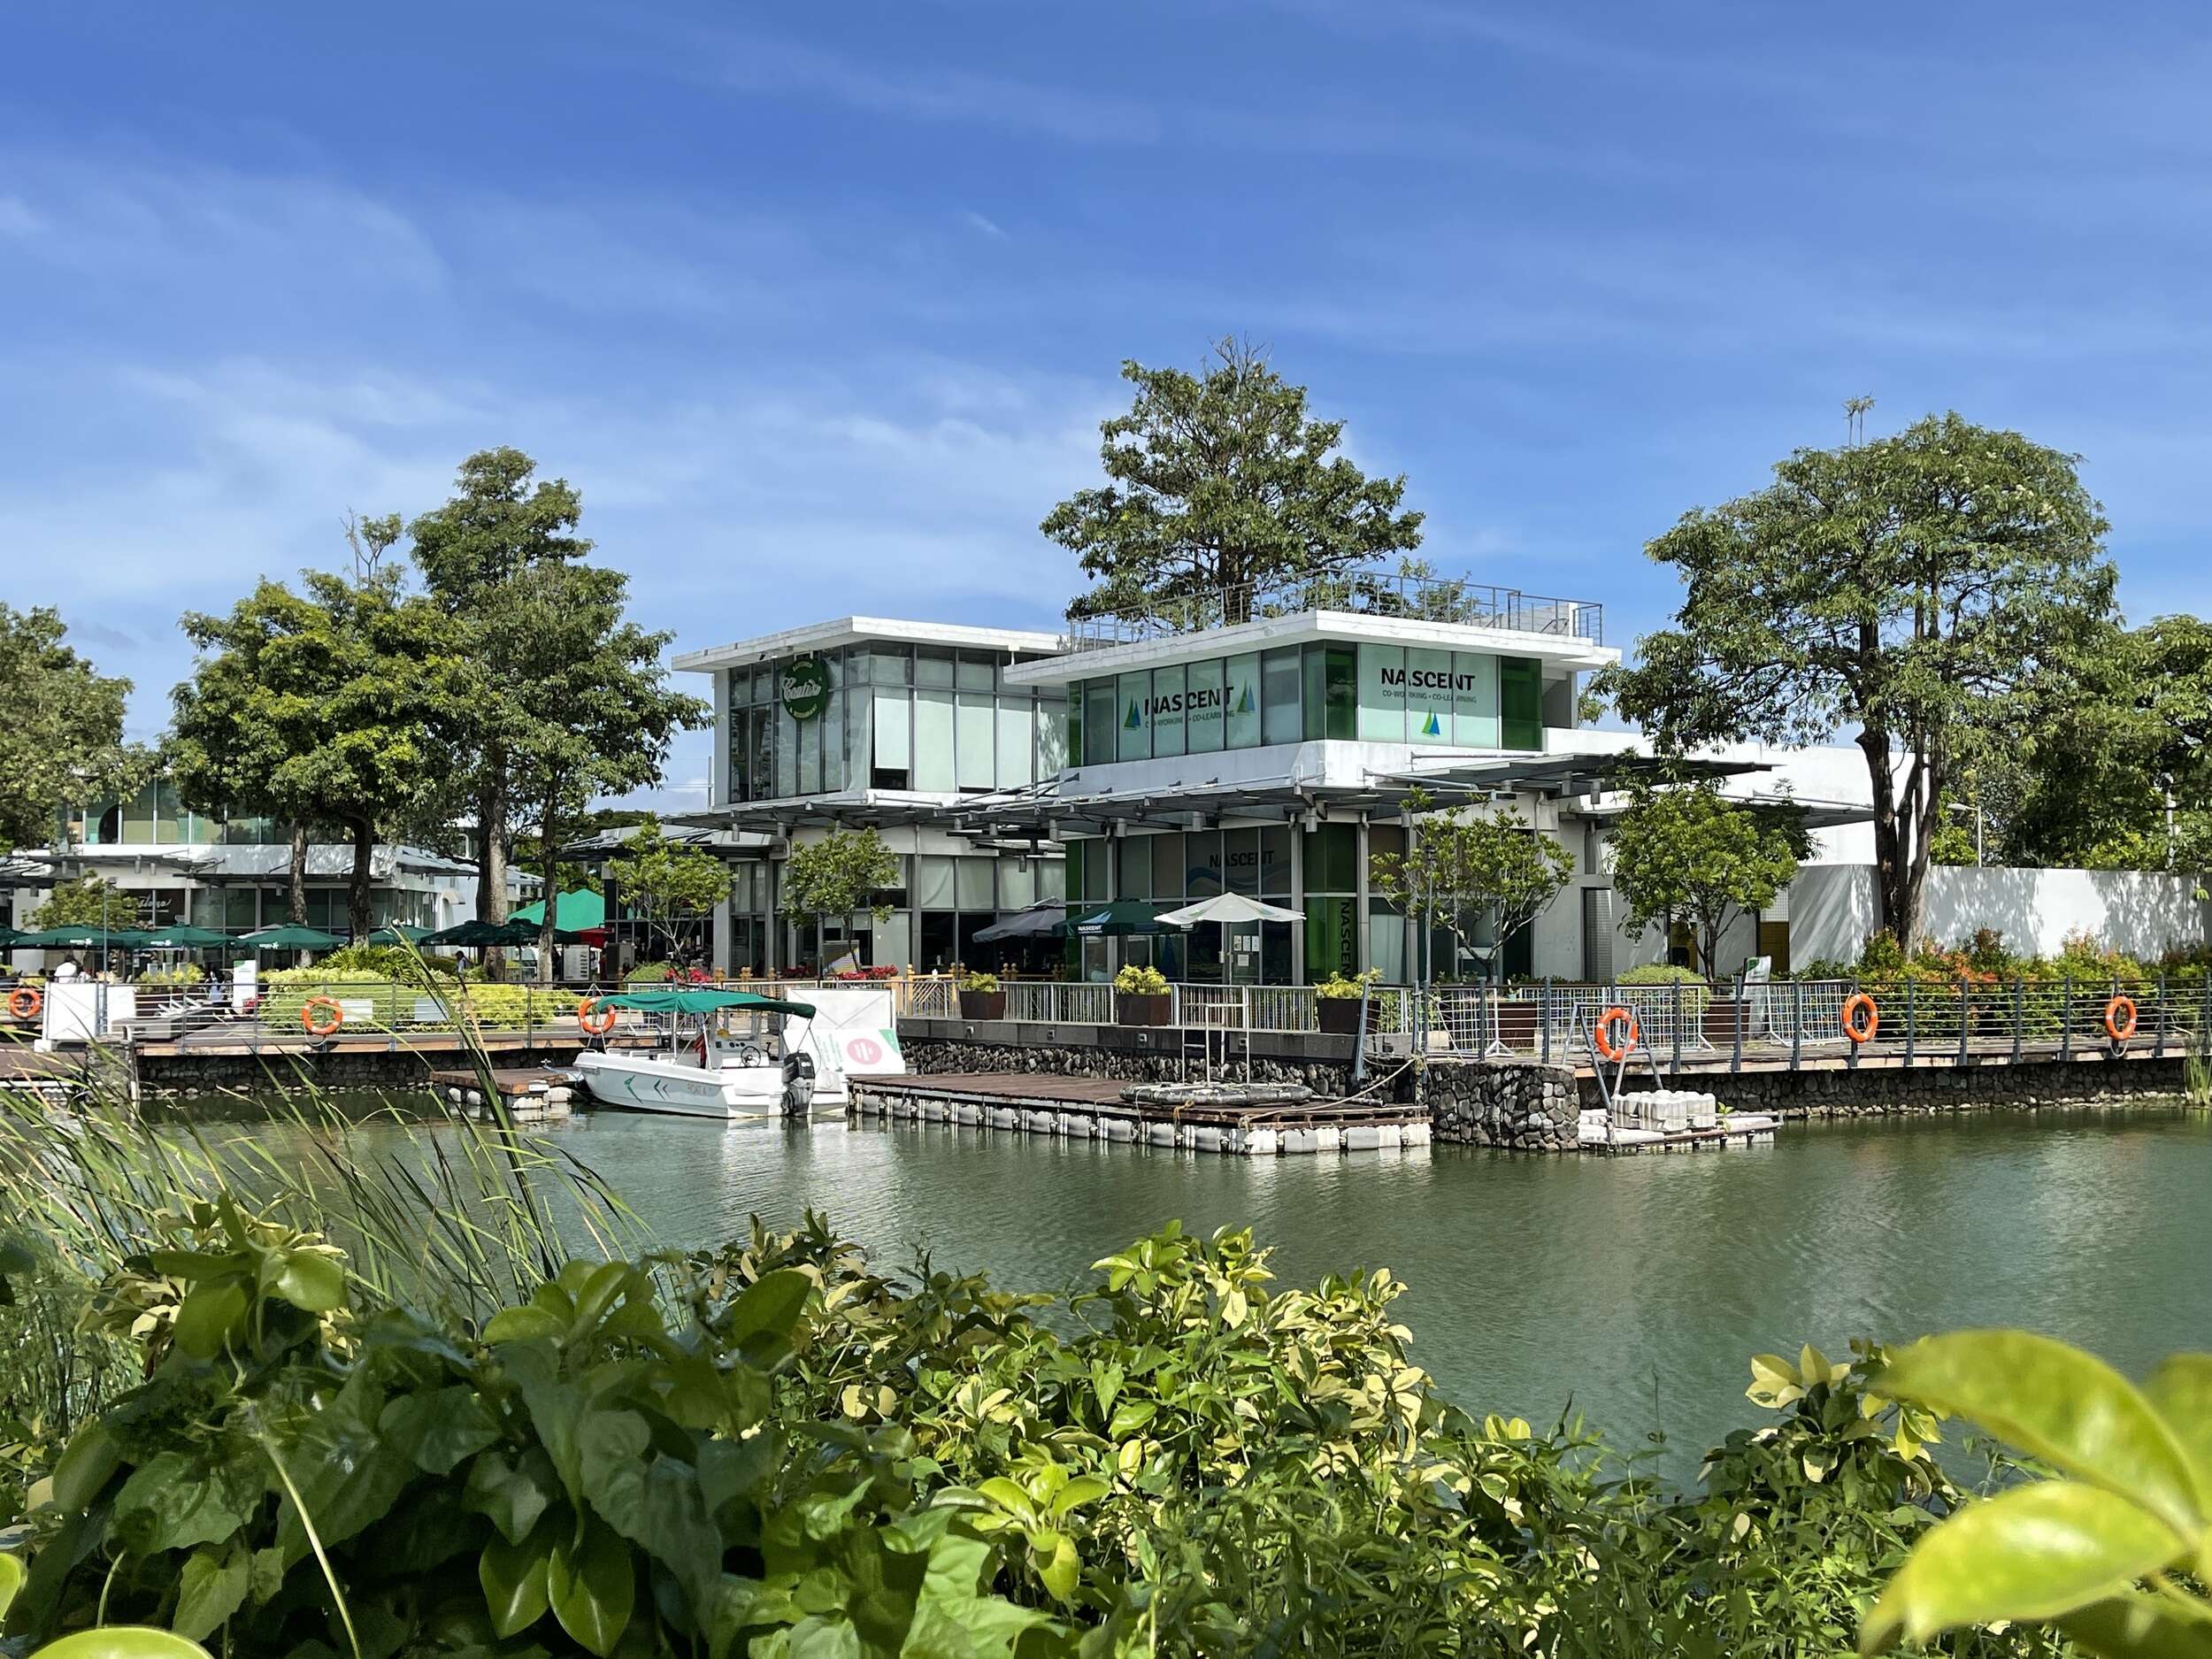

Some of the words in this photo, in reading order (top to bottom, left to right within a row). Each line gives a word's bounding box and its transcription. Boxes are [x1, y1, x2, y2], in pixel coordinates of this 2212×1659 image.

[1381, 668, 1476, 691] NASCENT
[1144, 687, 1234, 716] NASCENT
[1192, 710, 1235, 722] CO-LEARNNG
[1210, 850, 1275, 867] NASCENT
[1340, 902, 1351, 980] NASCEN
